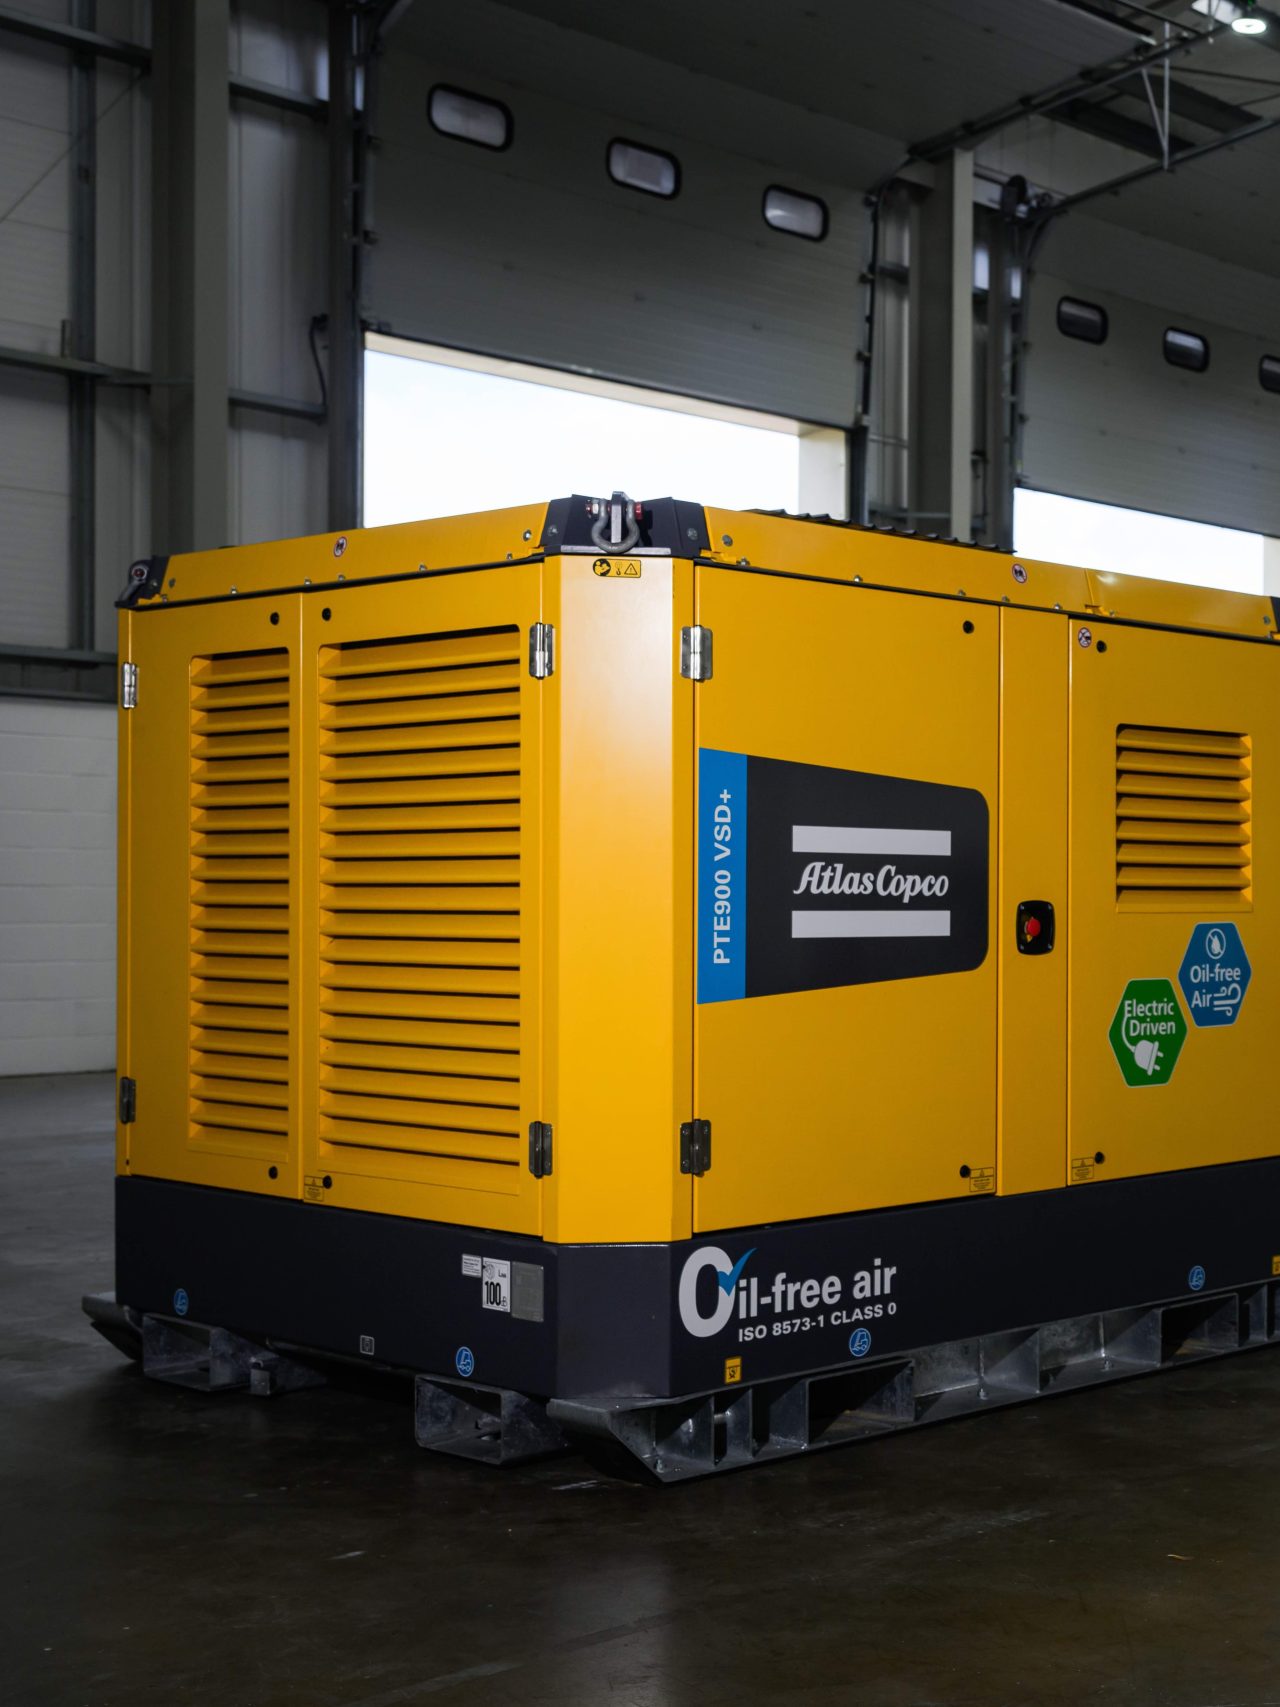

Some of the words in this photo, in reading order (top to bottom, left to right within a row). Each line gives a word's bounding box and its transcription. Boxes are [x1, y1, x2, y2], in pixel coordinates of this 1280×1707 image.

[713, 789, 732, 862] VSD+
[713, 869, 732, 964] PTE900
[1190, 963, 1242, 984] Oil-free
[1124, 997, 1175, 1018] Electric
[1191, 989, 1213, 1009] Air
[1129, 1018, 1176, 1037] Driven
[484, 1280, 502, 1306] 100
[678, 1246, 842, 1338] Oil-free
[853, 1257, 897, 1300] air
[738, 1324, 768, 1342] ISO
[771, 1315, 826, 1337] 8573-1
[830, 1303, 883, 1326] CLASS
[887, 1301, 898, 1316] 0
